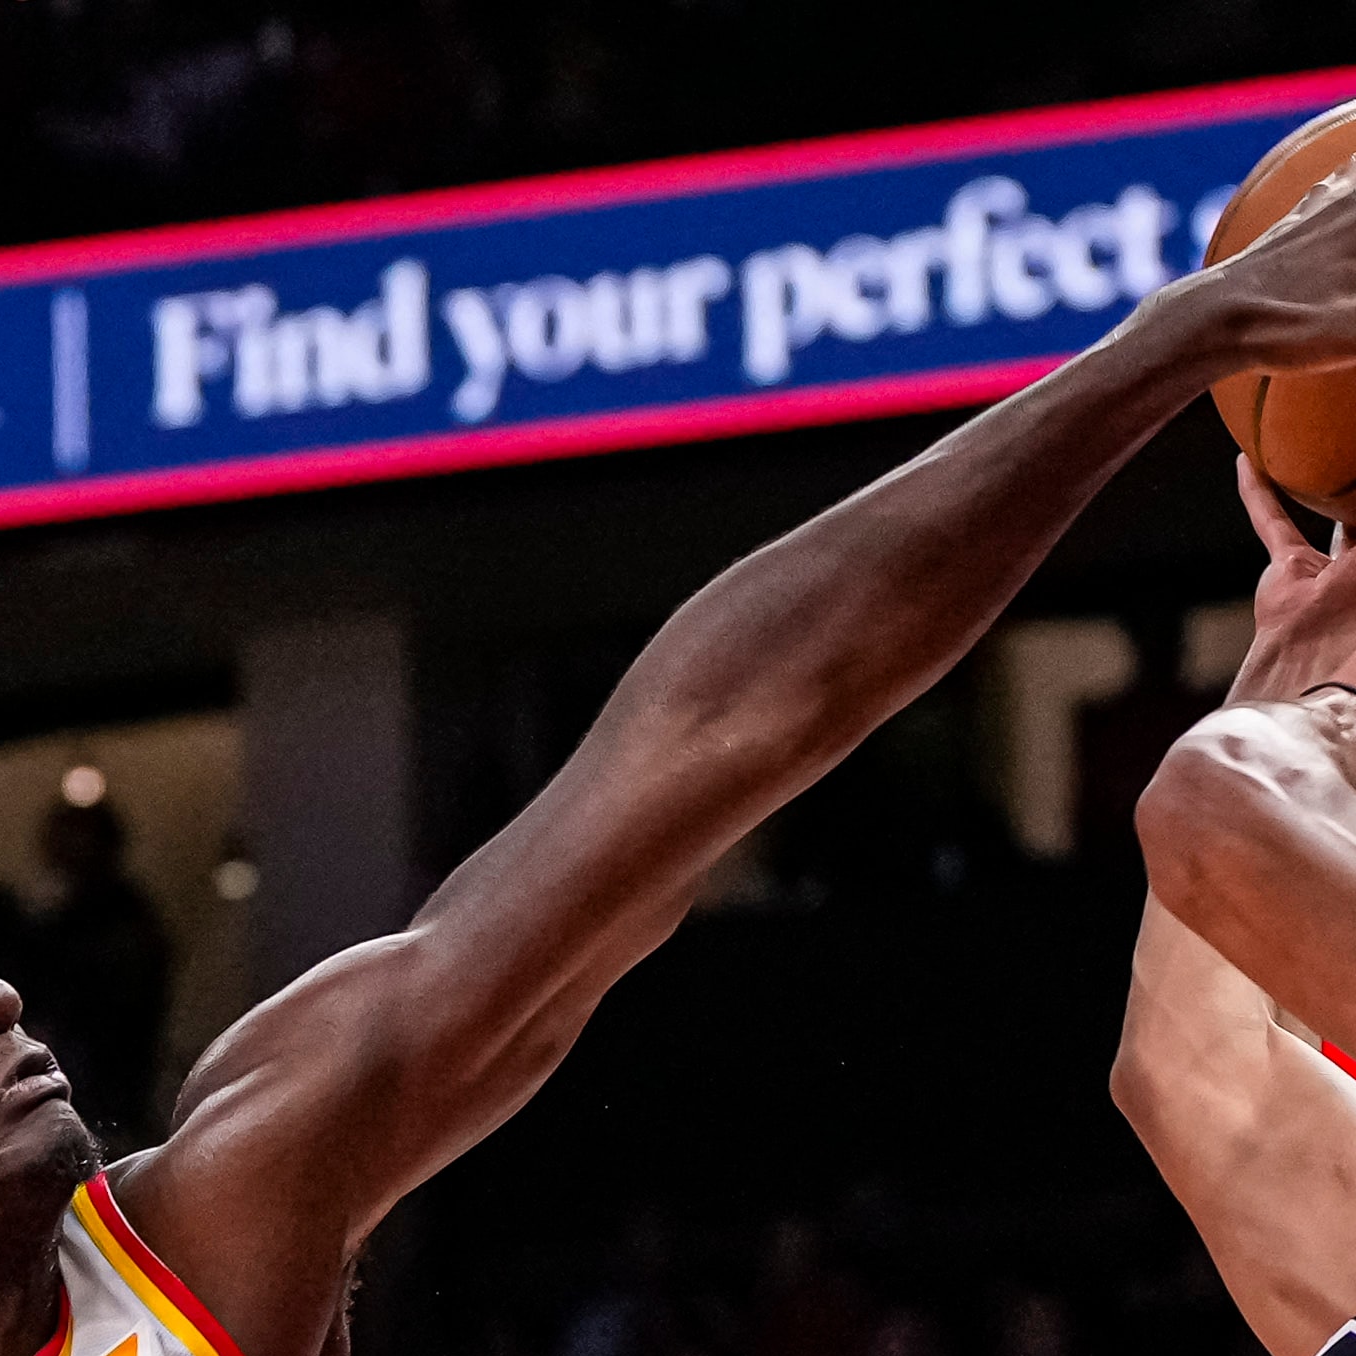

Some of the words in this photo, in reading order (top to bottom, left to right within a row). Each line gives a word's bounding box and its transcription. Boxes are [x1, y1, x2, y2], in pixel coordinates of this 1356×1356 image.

[152, 256, 431, 428] Find
[444, 253, 730, 423] your
[741, 174, 1179, 385] perfect
